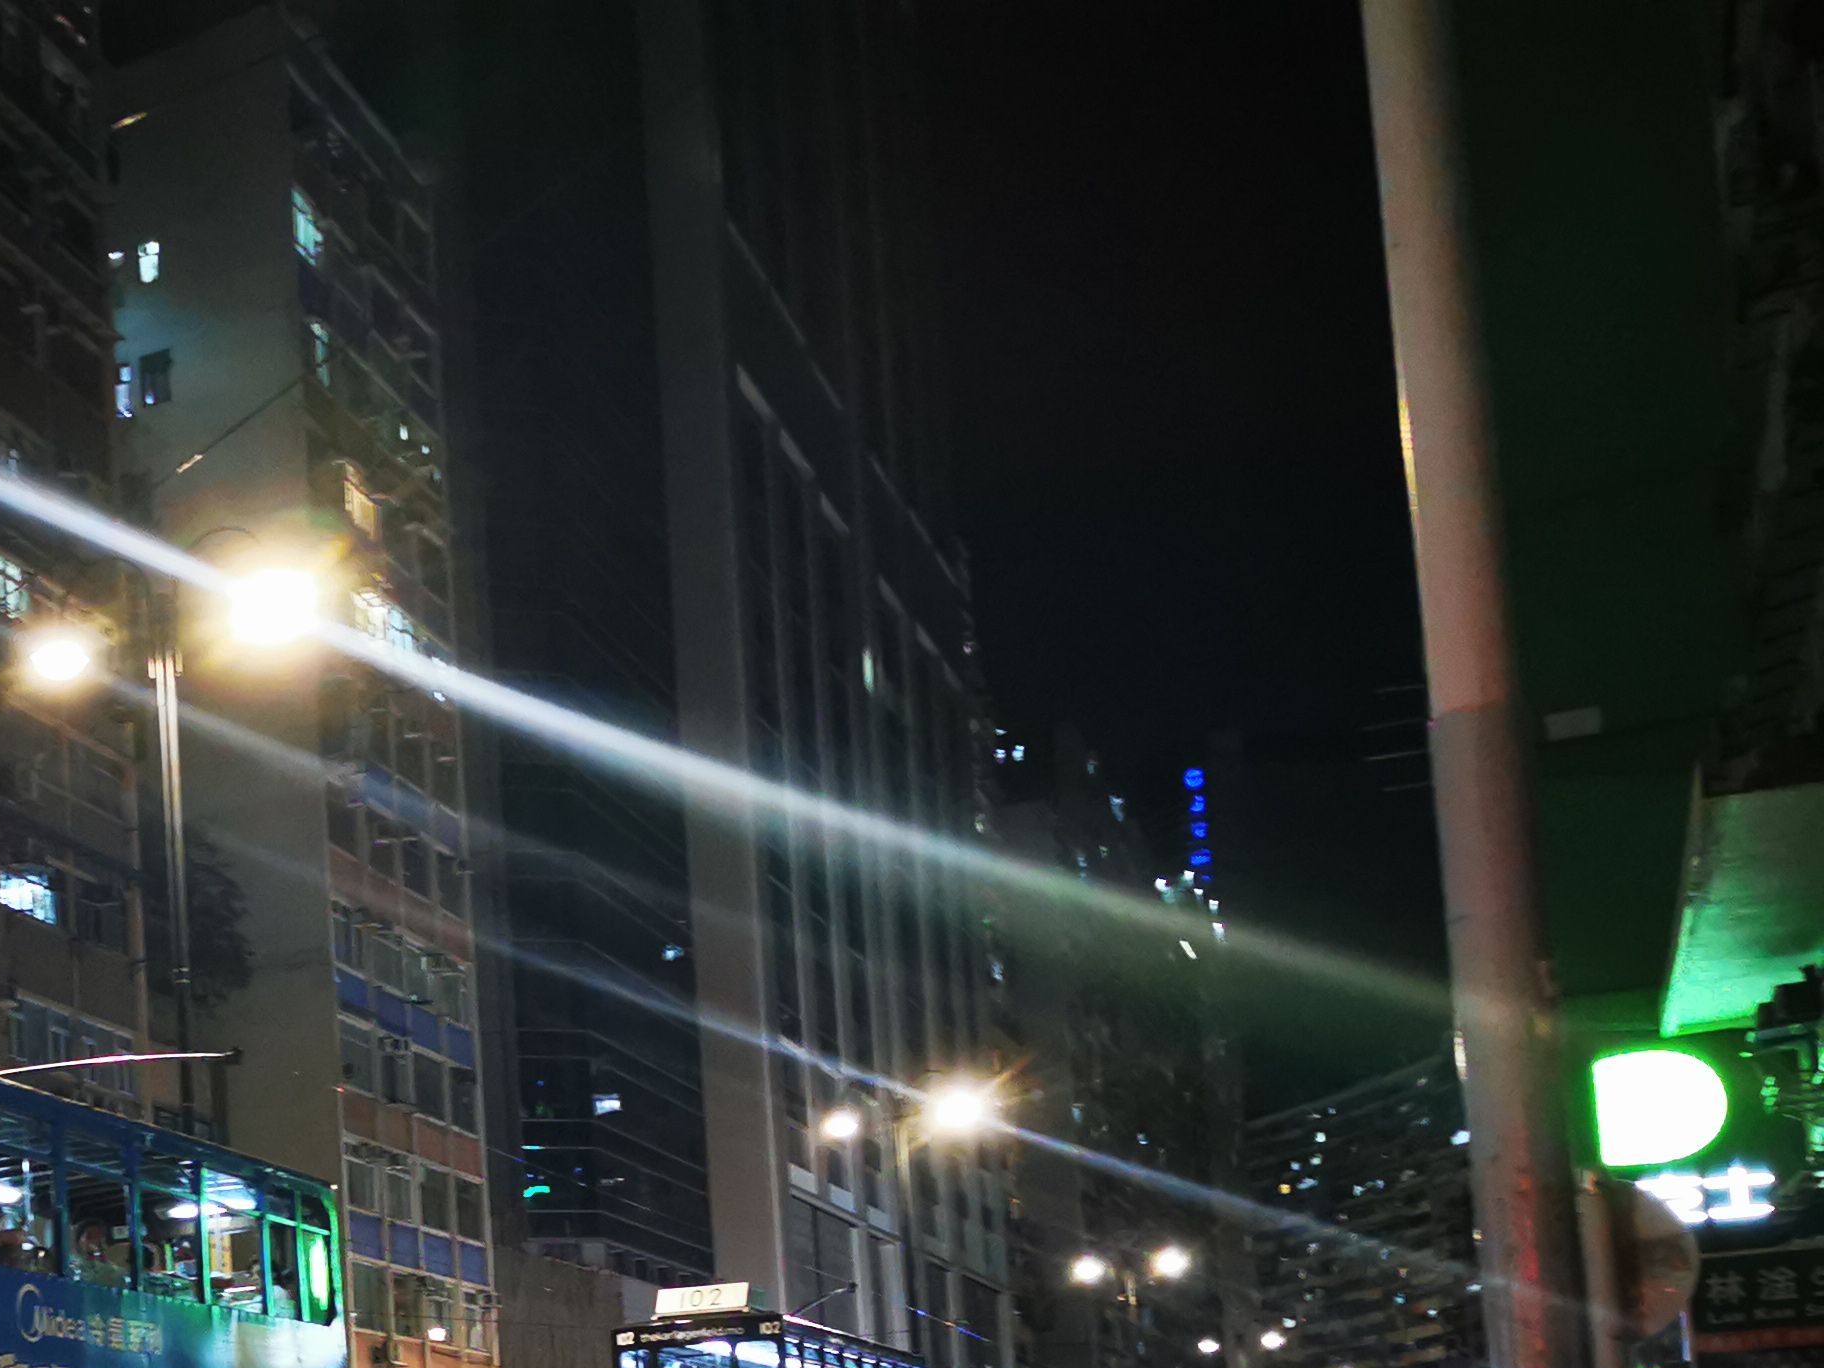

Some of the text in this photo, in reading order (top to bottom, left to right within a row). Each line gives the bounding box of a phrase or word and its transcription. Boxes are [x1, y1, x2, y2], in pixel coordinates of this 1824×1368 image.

[679, 1287, 722, 1309] 102
[15, 1282, 85, 1344] Midea
[758, 1321, 782, 1335] 102
